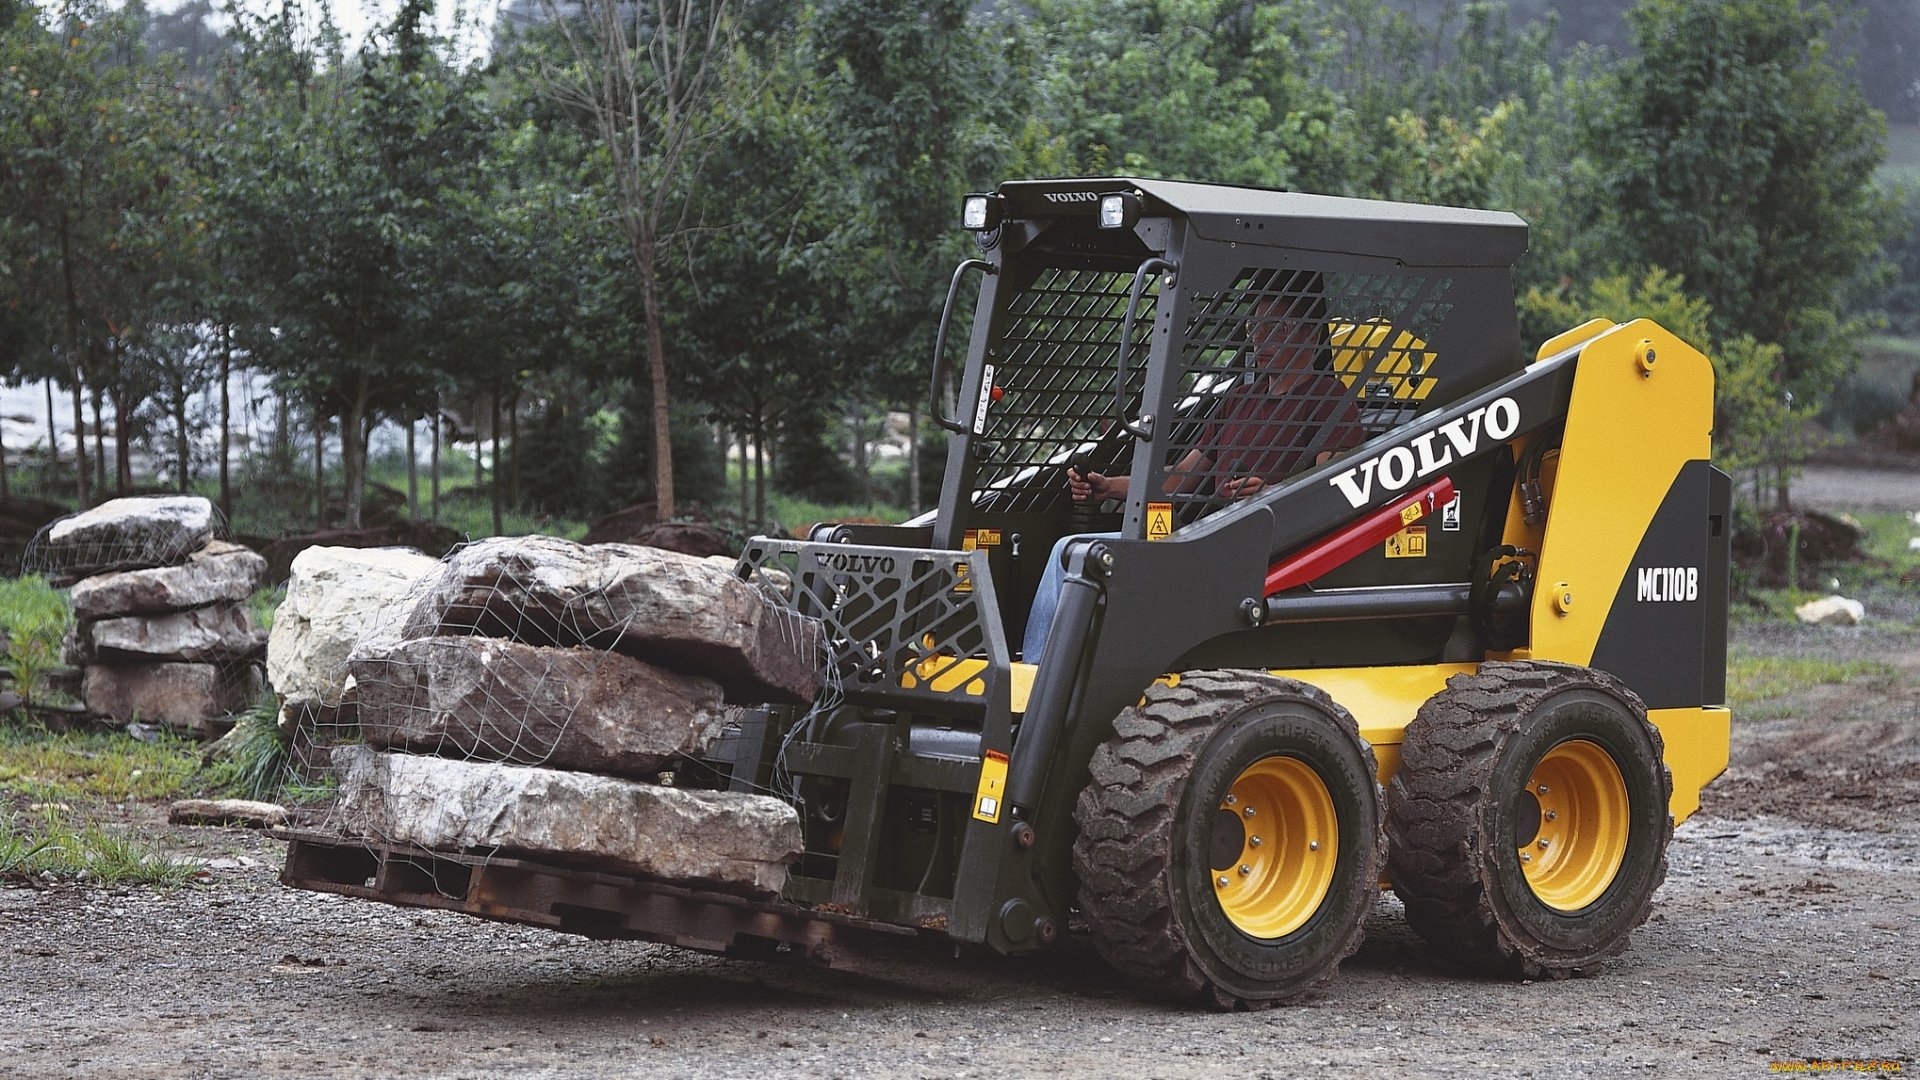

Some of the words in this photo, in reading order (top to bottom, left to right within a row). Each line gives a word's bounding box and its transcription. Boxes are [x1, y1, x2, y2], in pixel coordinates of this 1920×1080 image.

[1043, 191, 1098, 203] VOLVO
[1329, 396, 1521, 510] VOLVO
[814, 552, 895, 574] VOLVO
[1637, 567, 1698, 602] MC110B
